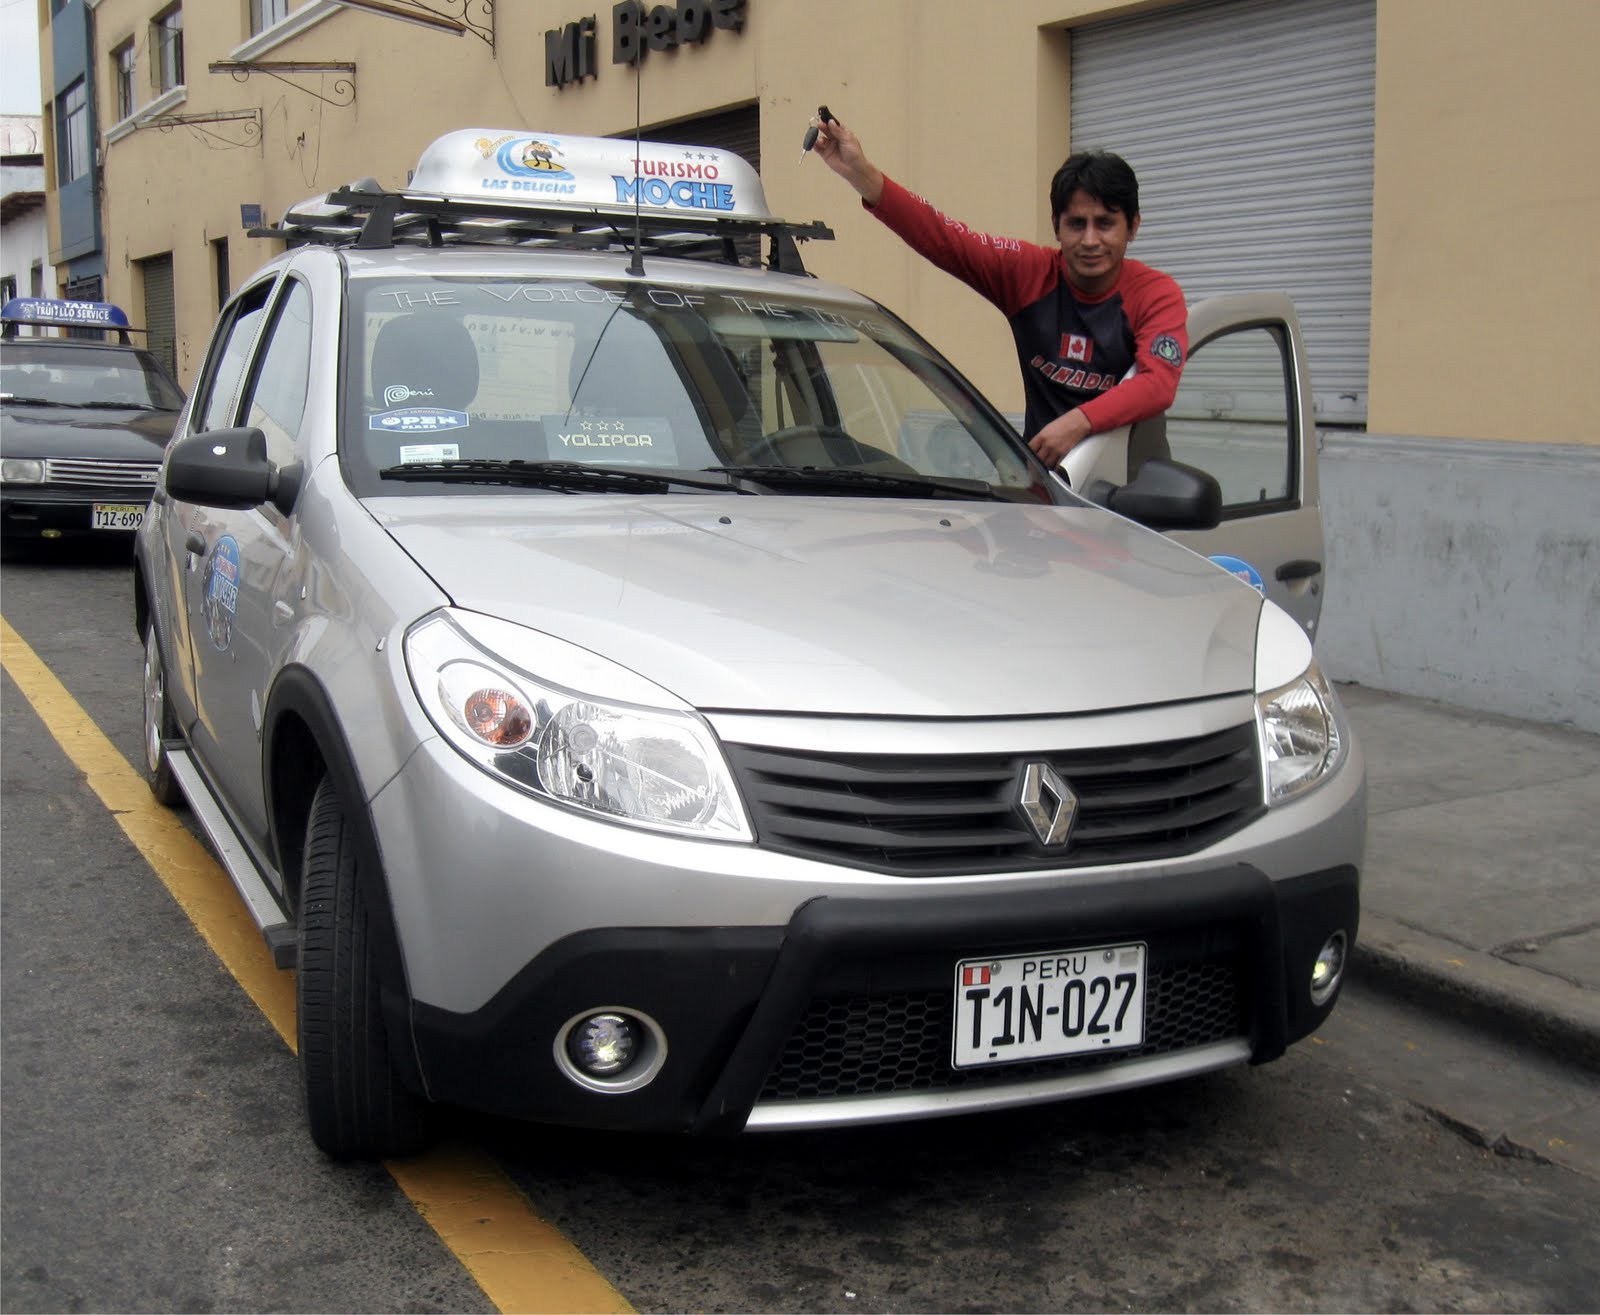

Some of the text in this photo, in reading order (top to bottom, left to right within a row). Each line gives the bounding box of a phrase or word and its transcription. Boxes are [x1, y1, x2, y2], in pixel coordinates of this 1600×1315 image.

[545, 14, 598, 90] Mi
[630, 159, 719, 180] TURISMO
[481, 178, 576, 194] LAS DELICIAS
[612, 175, 735, 211] MOCHE
[381, 290, 461, 308] THE
[478, 285, 633, 305] VOICE
[647, 289, 705, 312] OF
[720, 295, 794, 318] THE
[77, 309, 110, 321] SERVICE
[1031, 355, 1116, 391] CANADA
[381, 416, 458, 426] OPEN
[96, 511, 143, 527] T1Z-699
[1022, 956, 1087, 981] PERU
[965, 972, 1137, 1049] T1N-027
